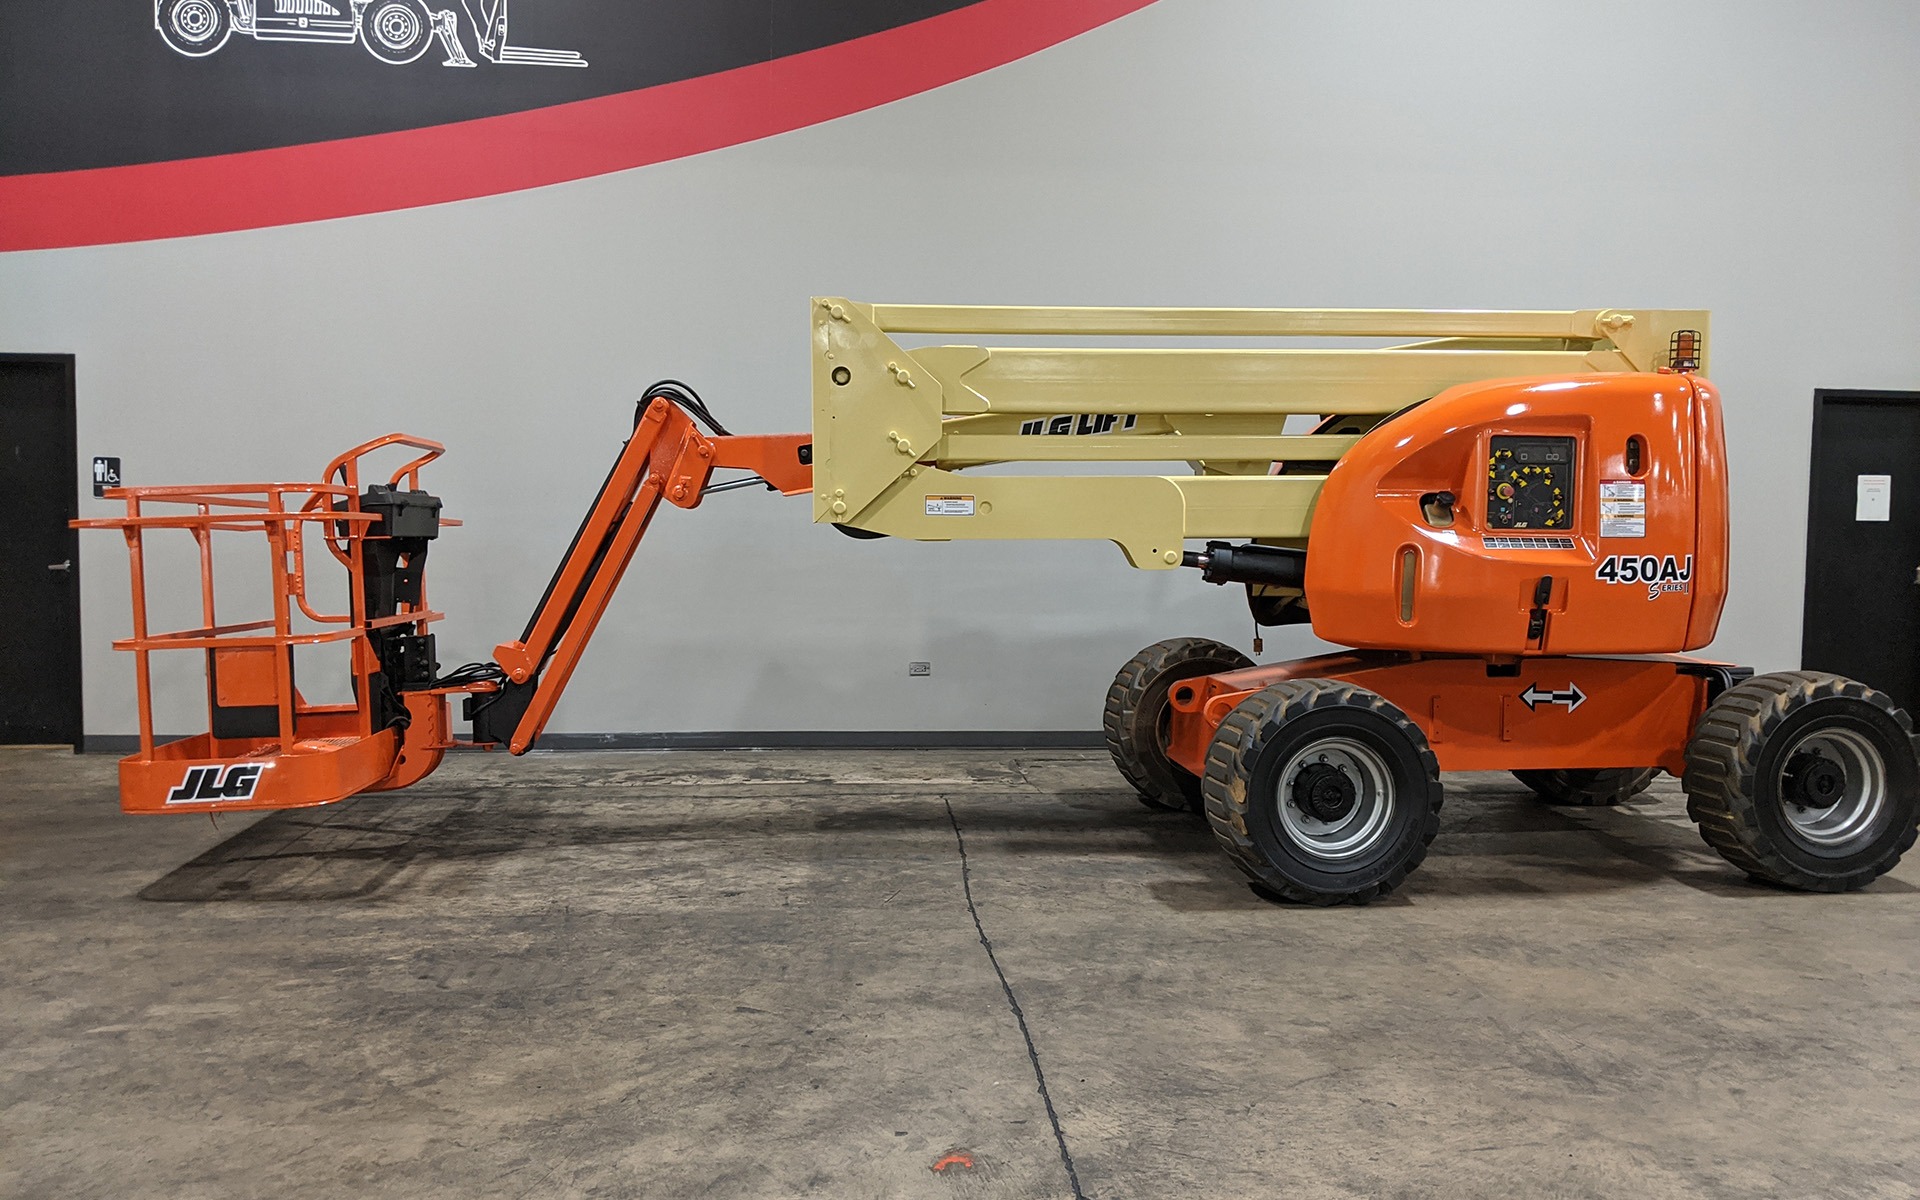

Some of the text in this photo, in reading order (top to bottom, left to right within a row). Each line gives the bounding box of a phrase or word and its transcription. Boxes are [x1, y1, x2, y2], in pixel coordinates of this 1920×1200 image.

[1597, 556, 1692, 582] 450AJ
[1648, 582, 1683, 600] SERIES
[167, 763, 264, 803] JLG
